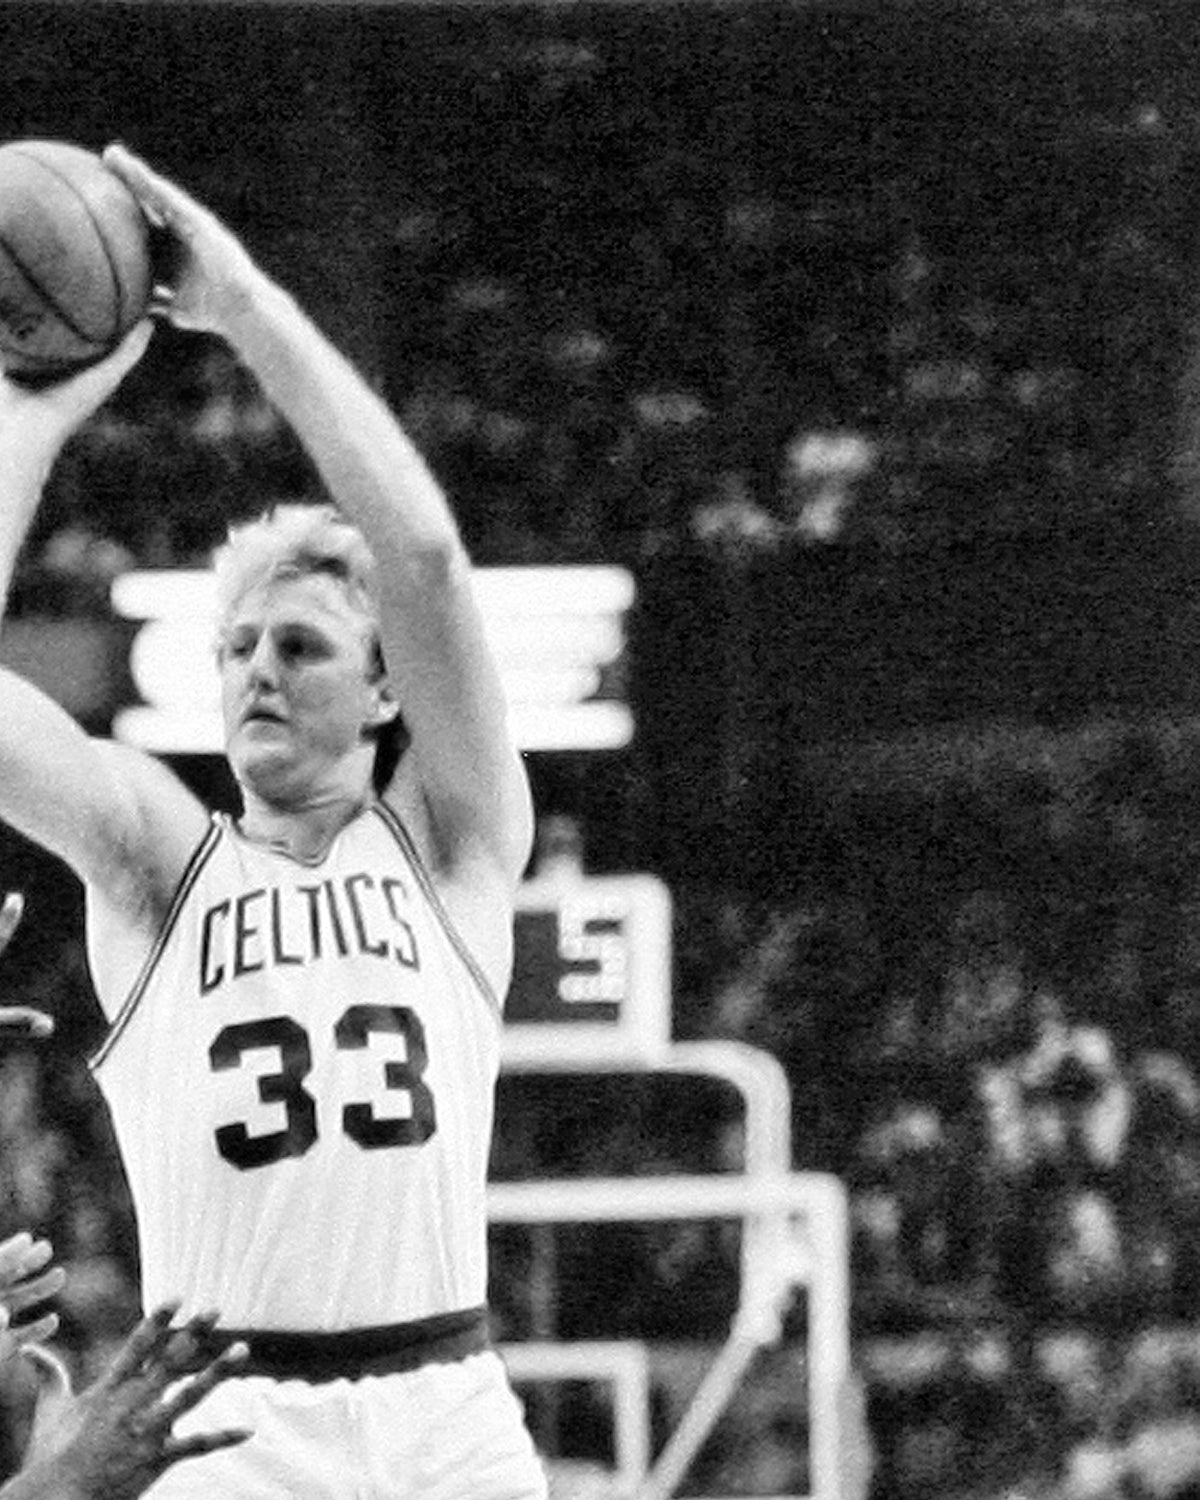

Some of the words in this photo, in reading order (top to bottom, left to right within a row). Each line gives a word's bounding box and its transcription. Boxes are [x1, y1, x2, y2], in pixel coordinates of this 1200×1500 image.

[199, 873, 421, 997] CELTICS
[557, 896, 629, 1004] 5
[208, 1003, 438, 1172] 33
